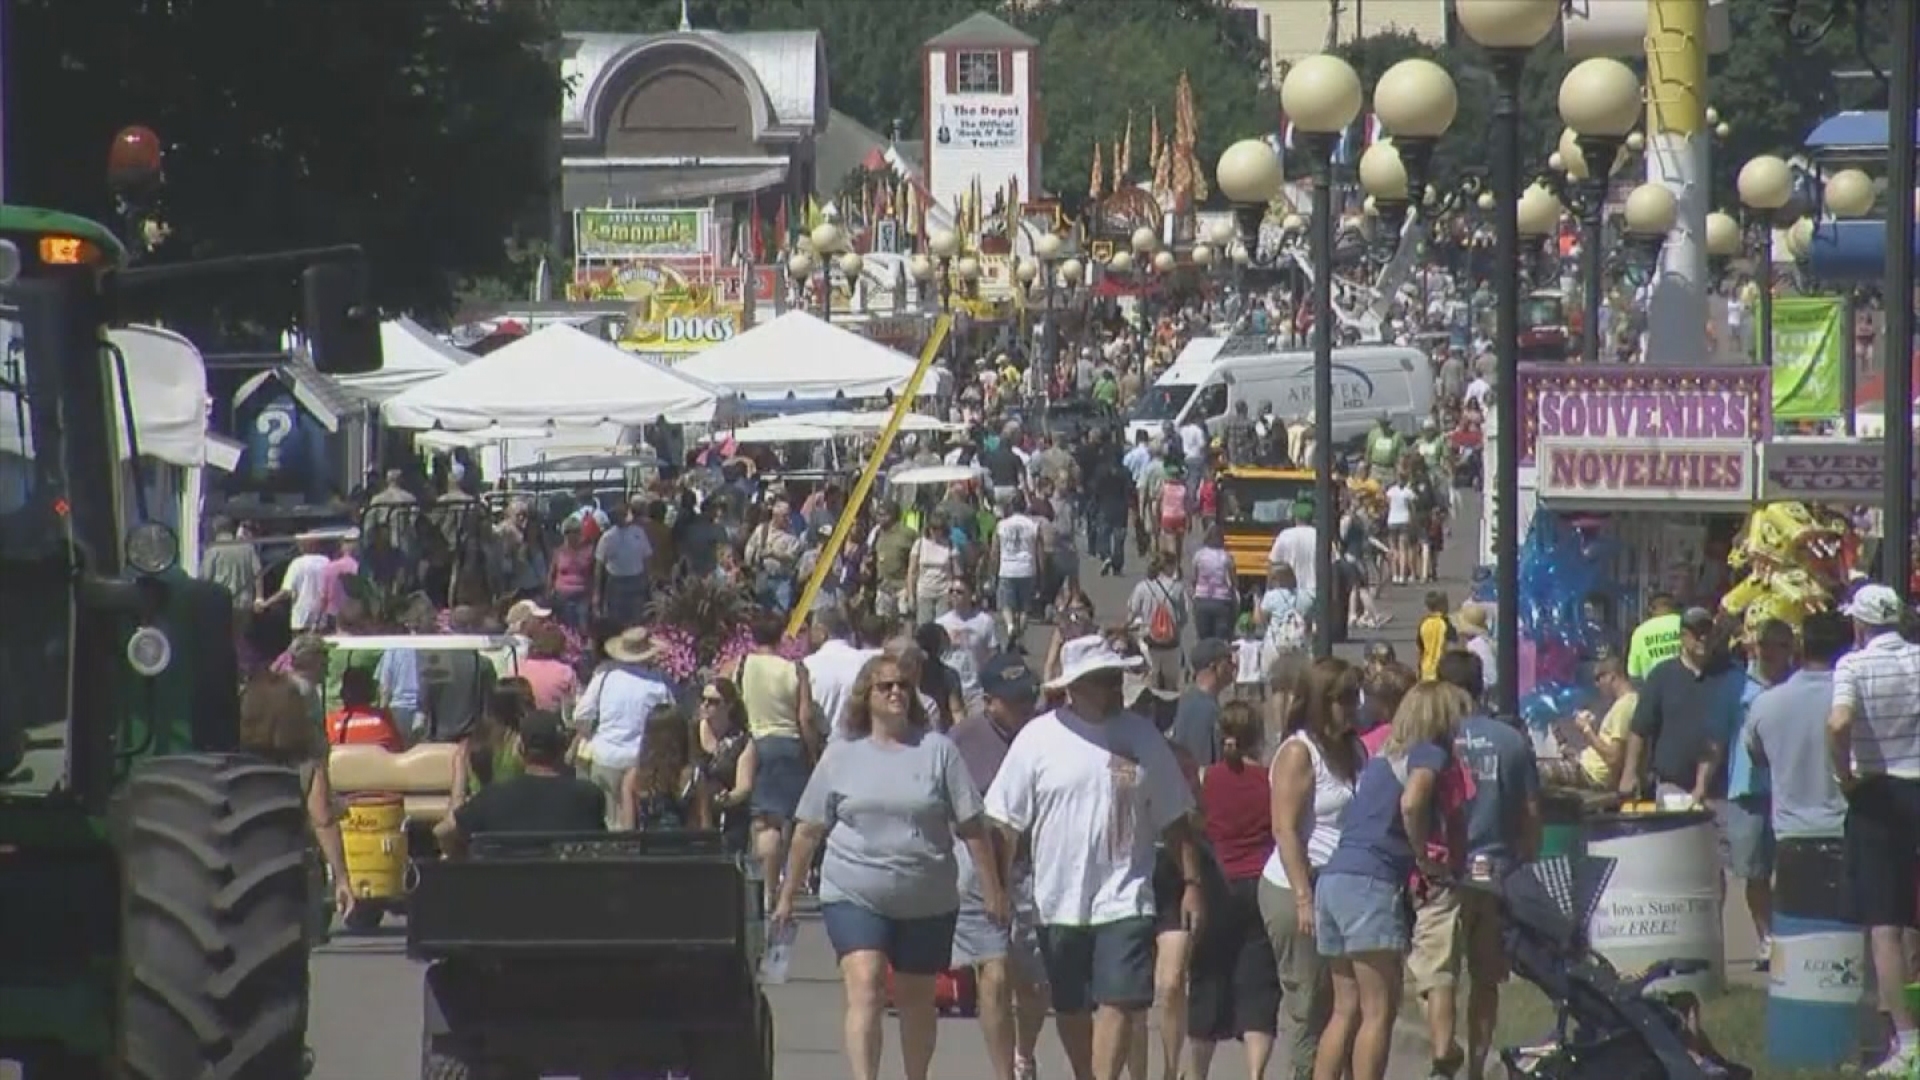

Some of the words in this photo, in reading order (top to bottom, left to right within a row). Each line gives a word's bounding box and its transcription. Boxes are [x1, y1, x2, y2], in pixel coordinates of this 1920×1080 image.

[954, 105, 976, 116] The
[981, 105, 1019, 119] Depot
[972, 139, 998, 148] Tent
[585, 219, 693, 243] Lemonade
[664, 317, 733, 342] DOGS
[1541, 394, 1746, 437] SOUVENIRS
[1550, 452, 1742, 488] NOVELTIES
[1612, 902, 1645, 918] Iowa
[1648, 900, 1685, 914] State
